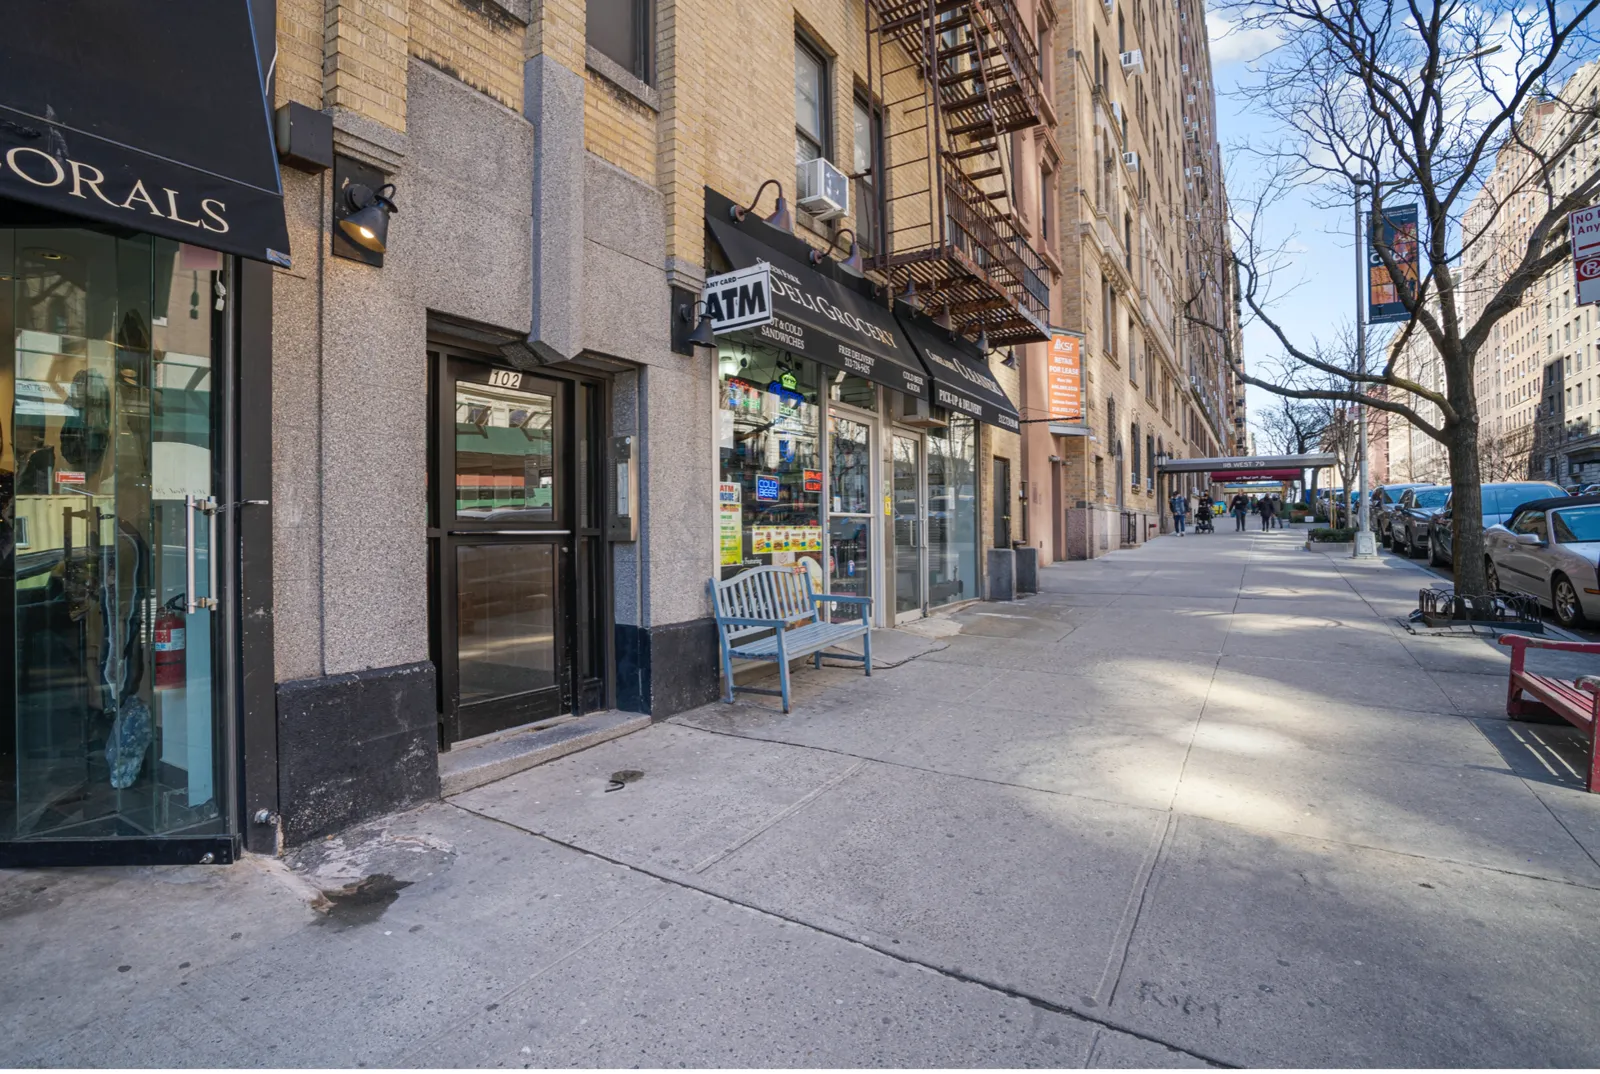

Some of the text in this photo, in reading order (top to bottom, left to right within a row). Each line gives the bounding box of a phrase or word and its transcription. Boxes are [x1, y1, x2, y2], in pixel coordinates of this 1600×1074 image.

[0, 147, 230, 233] ORALS
[1575, 212, 1593, 225] NO
[705, 276, 737, 289] ANY CARD
[706, 281, 767, 322] ATM
[769, 273, 898, 349] DELI GROCERY
[768, 317, 779, 327] OT
[784, 319, 803, 337] COLD
[761, 325, 805, 350] SANDWICHES
[838, 344, 875, 367] FREE DELIVERY
[494, 370, 520, 388] 102
[902, 370, 914, 382] COLD
[1049, 365, 1079, 376] FOR LEASE
[938, 388, 959, 407] PICK-UP
[962, 398, 983, 417] DELIVERY
[719, 485, 734, 493] ATM
[758, 480, 777, 490] COLD
[758, 489, 777, 498] BEER
